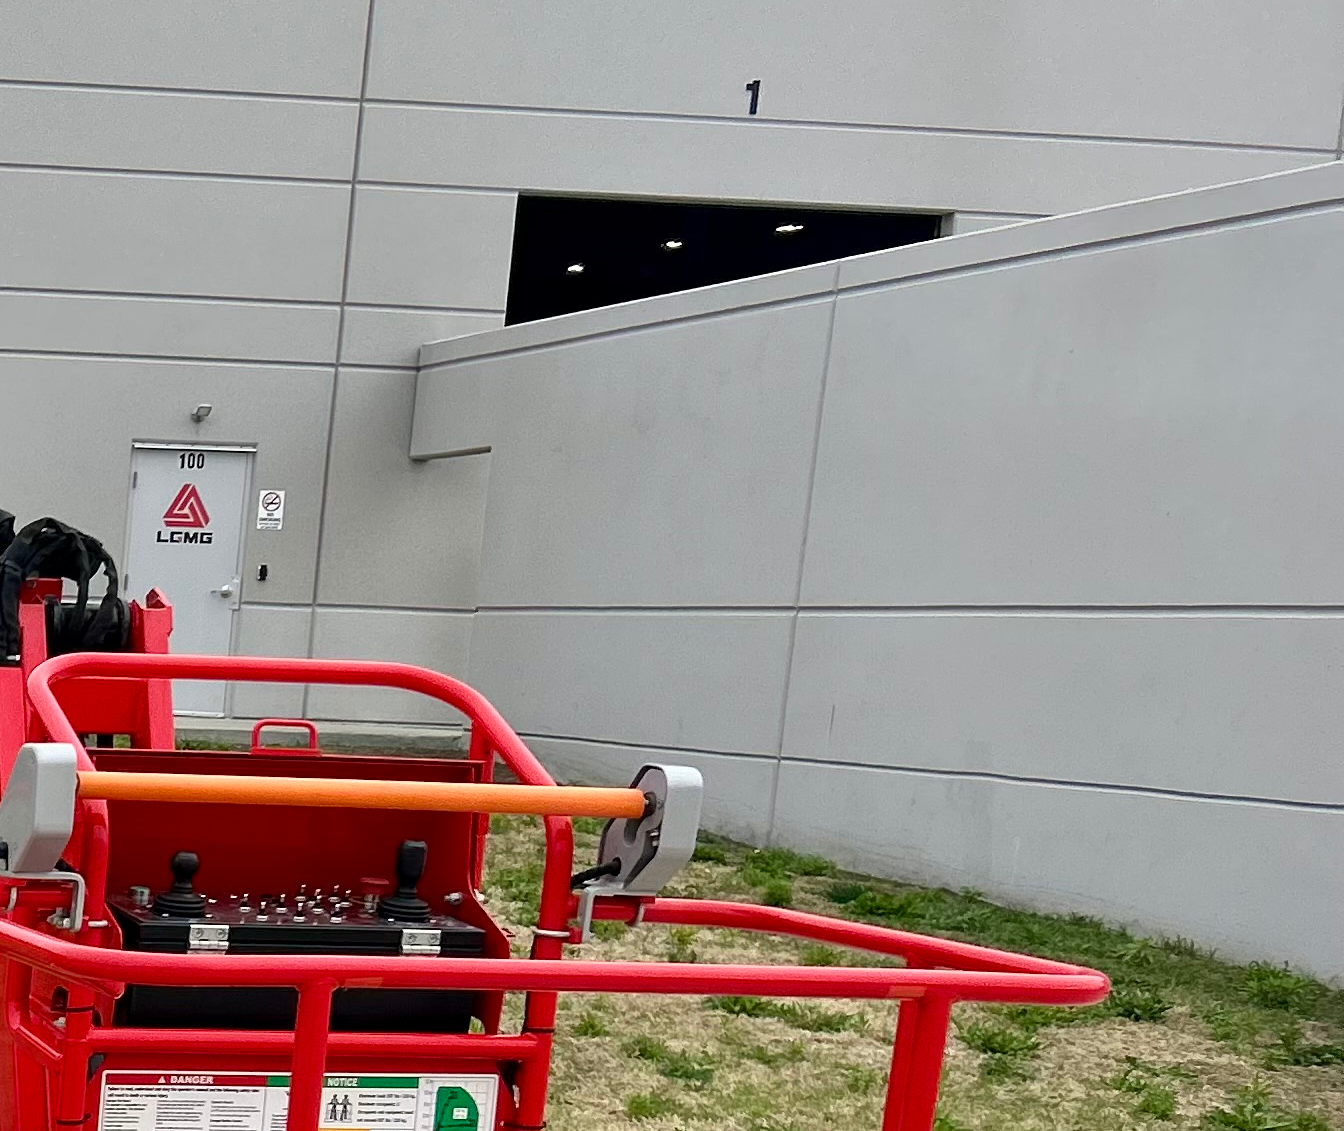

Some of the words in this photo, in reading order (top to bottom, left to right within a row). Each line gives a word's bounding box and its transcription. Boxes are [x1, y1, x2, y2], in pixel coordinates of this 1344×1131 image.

[746, 80, 761, 115] 1
[179, 453, 205, 469] 100
[156, 530, 213, 544] LGMG
[169, 1075, 214, 1084] DANGER
[327, 1078, 359, 1087] NOTICE
